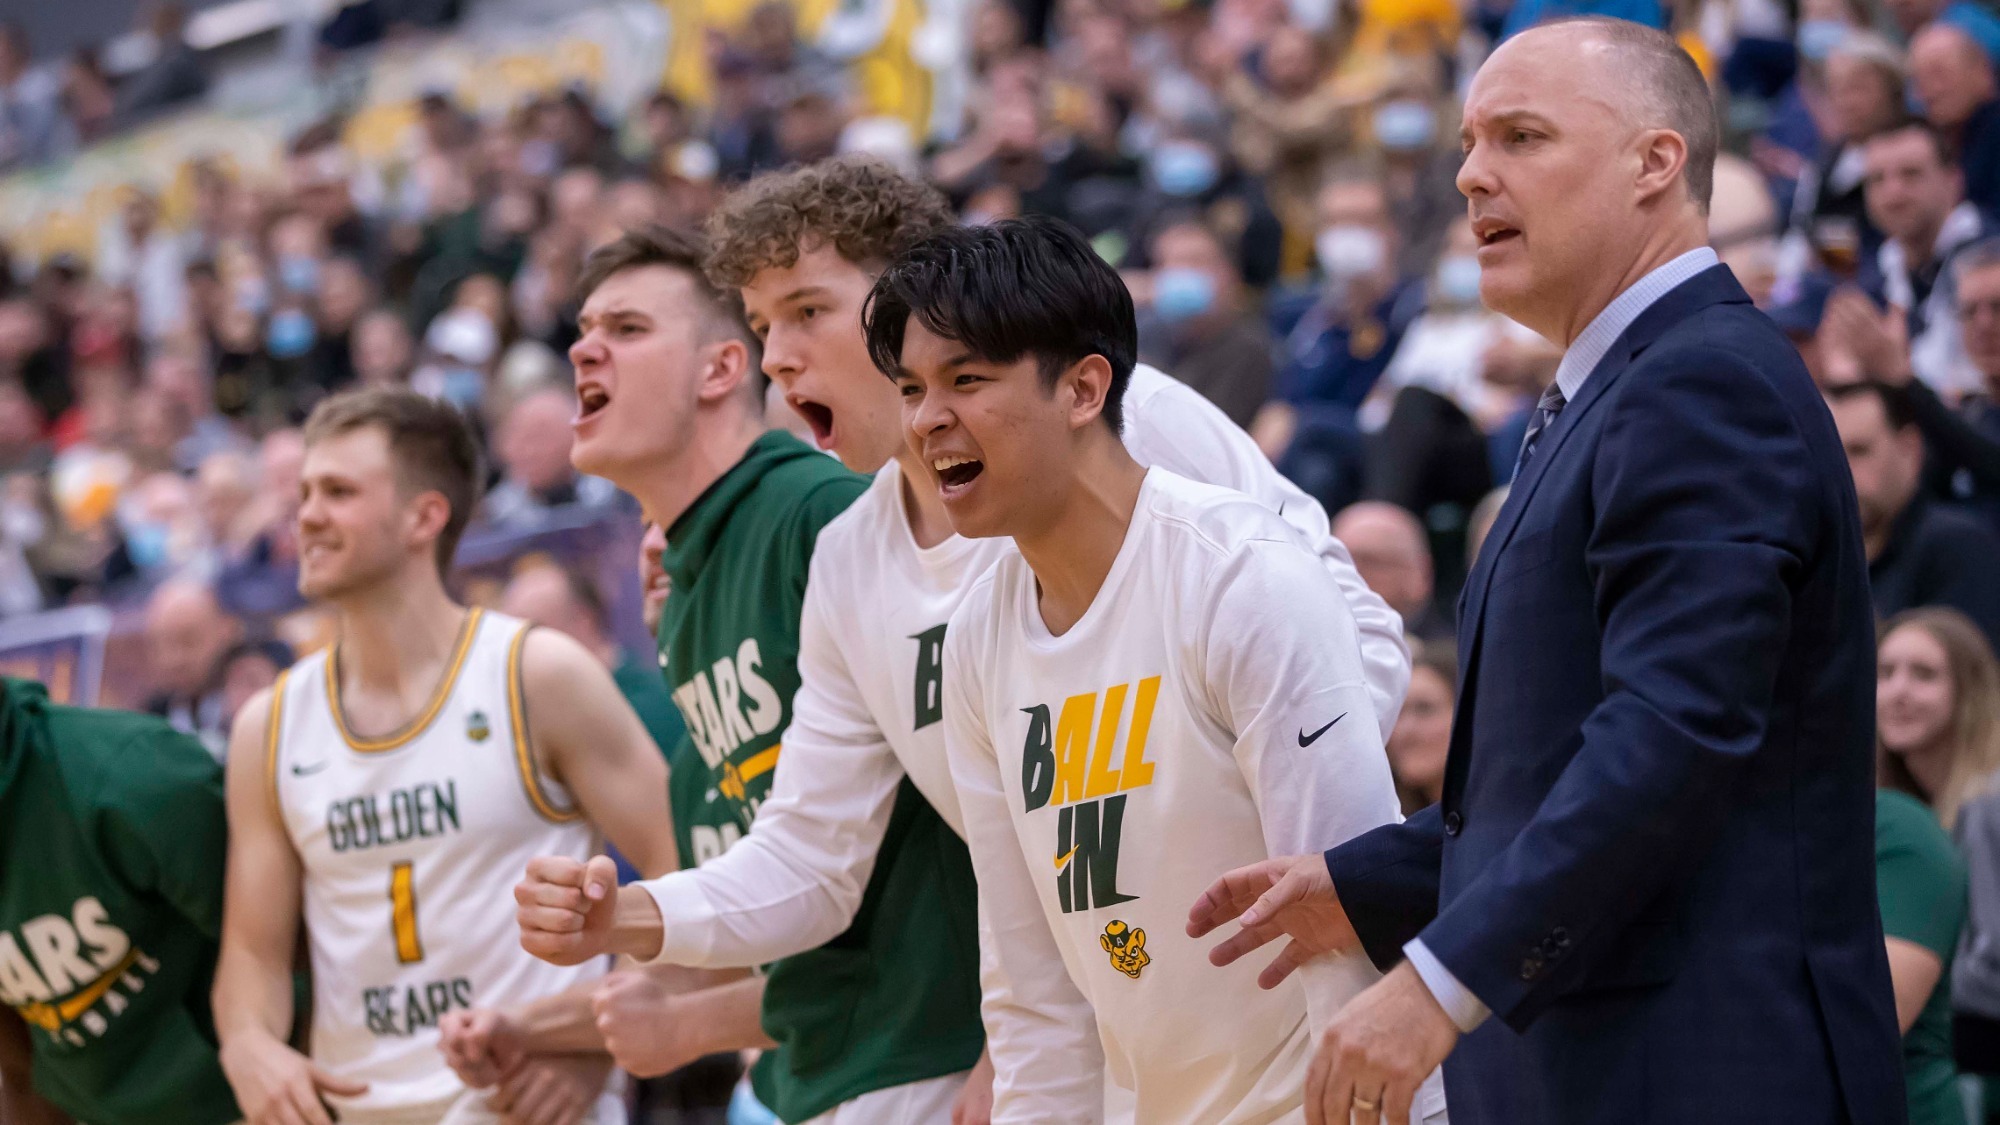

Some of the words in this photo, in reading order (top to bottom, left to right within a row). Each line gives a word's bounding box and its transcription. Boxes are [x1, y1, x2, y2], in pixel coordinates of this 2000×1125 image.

[1019, 675, 1162, 814] BALL
[327, 778, 461, 851] GOLDEN
[1054, 794, 1141, 914] IN
[390, 863, 424, 963] 1
